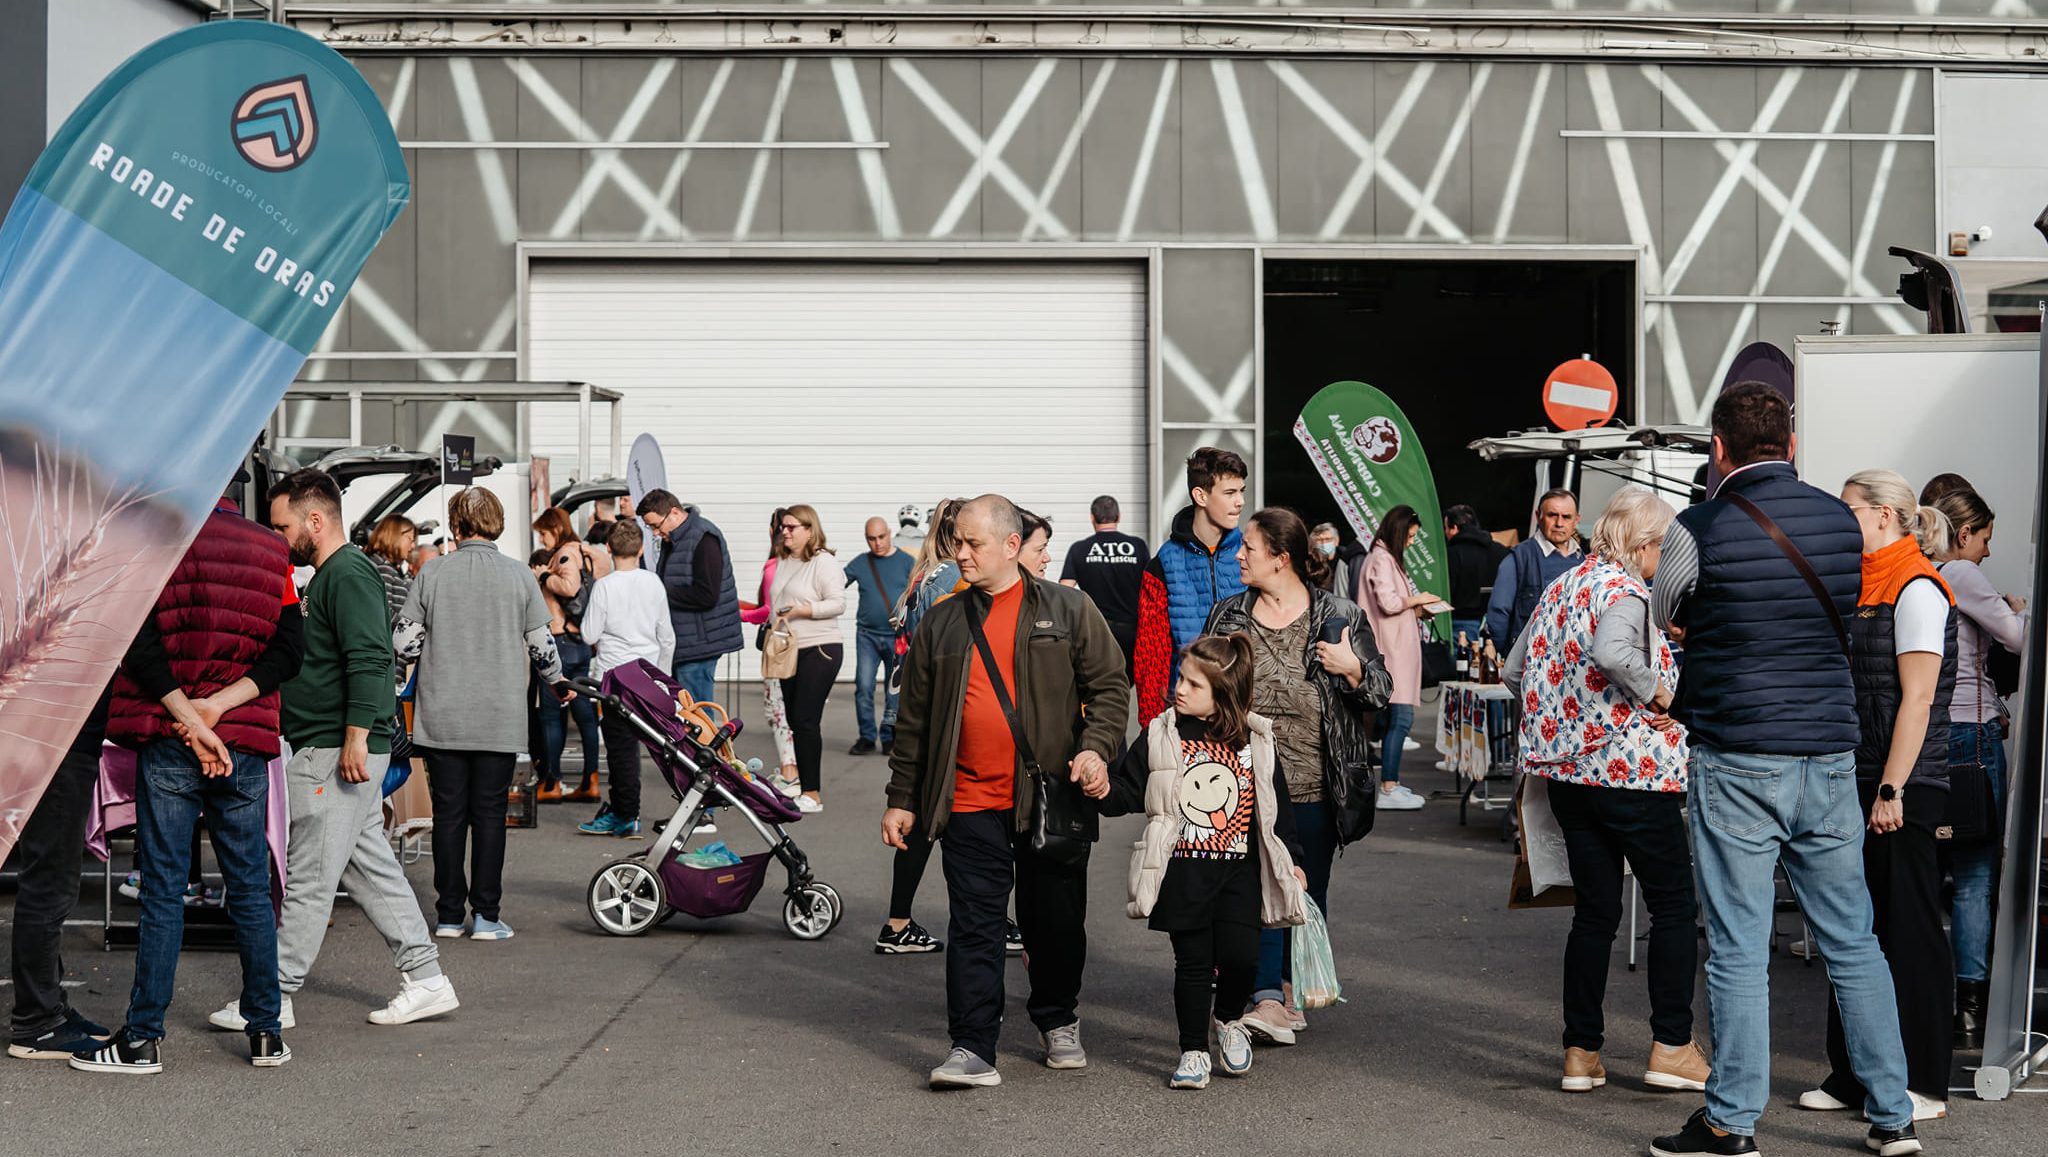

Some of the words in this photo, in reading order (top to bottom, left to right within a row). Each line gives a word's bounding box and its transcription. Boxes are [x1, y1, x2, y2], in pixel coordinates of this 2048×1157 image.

[171, 150, 256, 204] PRODUCATORI
[257, 198, 299, 237] LOCALI
[89, 142, 194, 221] ROADE
[202, 213, 246, 254] DE
[254, 246, 336, 308] ORAS
[1088, 542, 1135, 556] ATO
[1110, 556, 1137, 564] RESCUE
